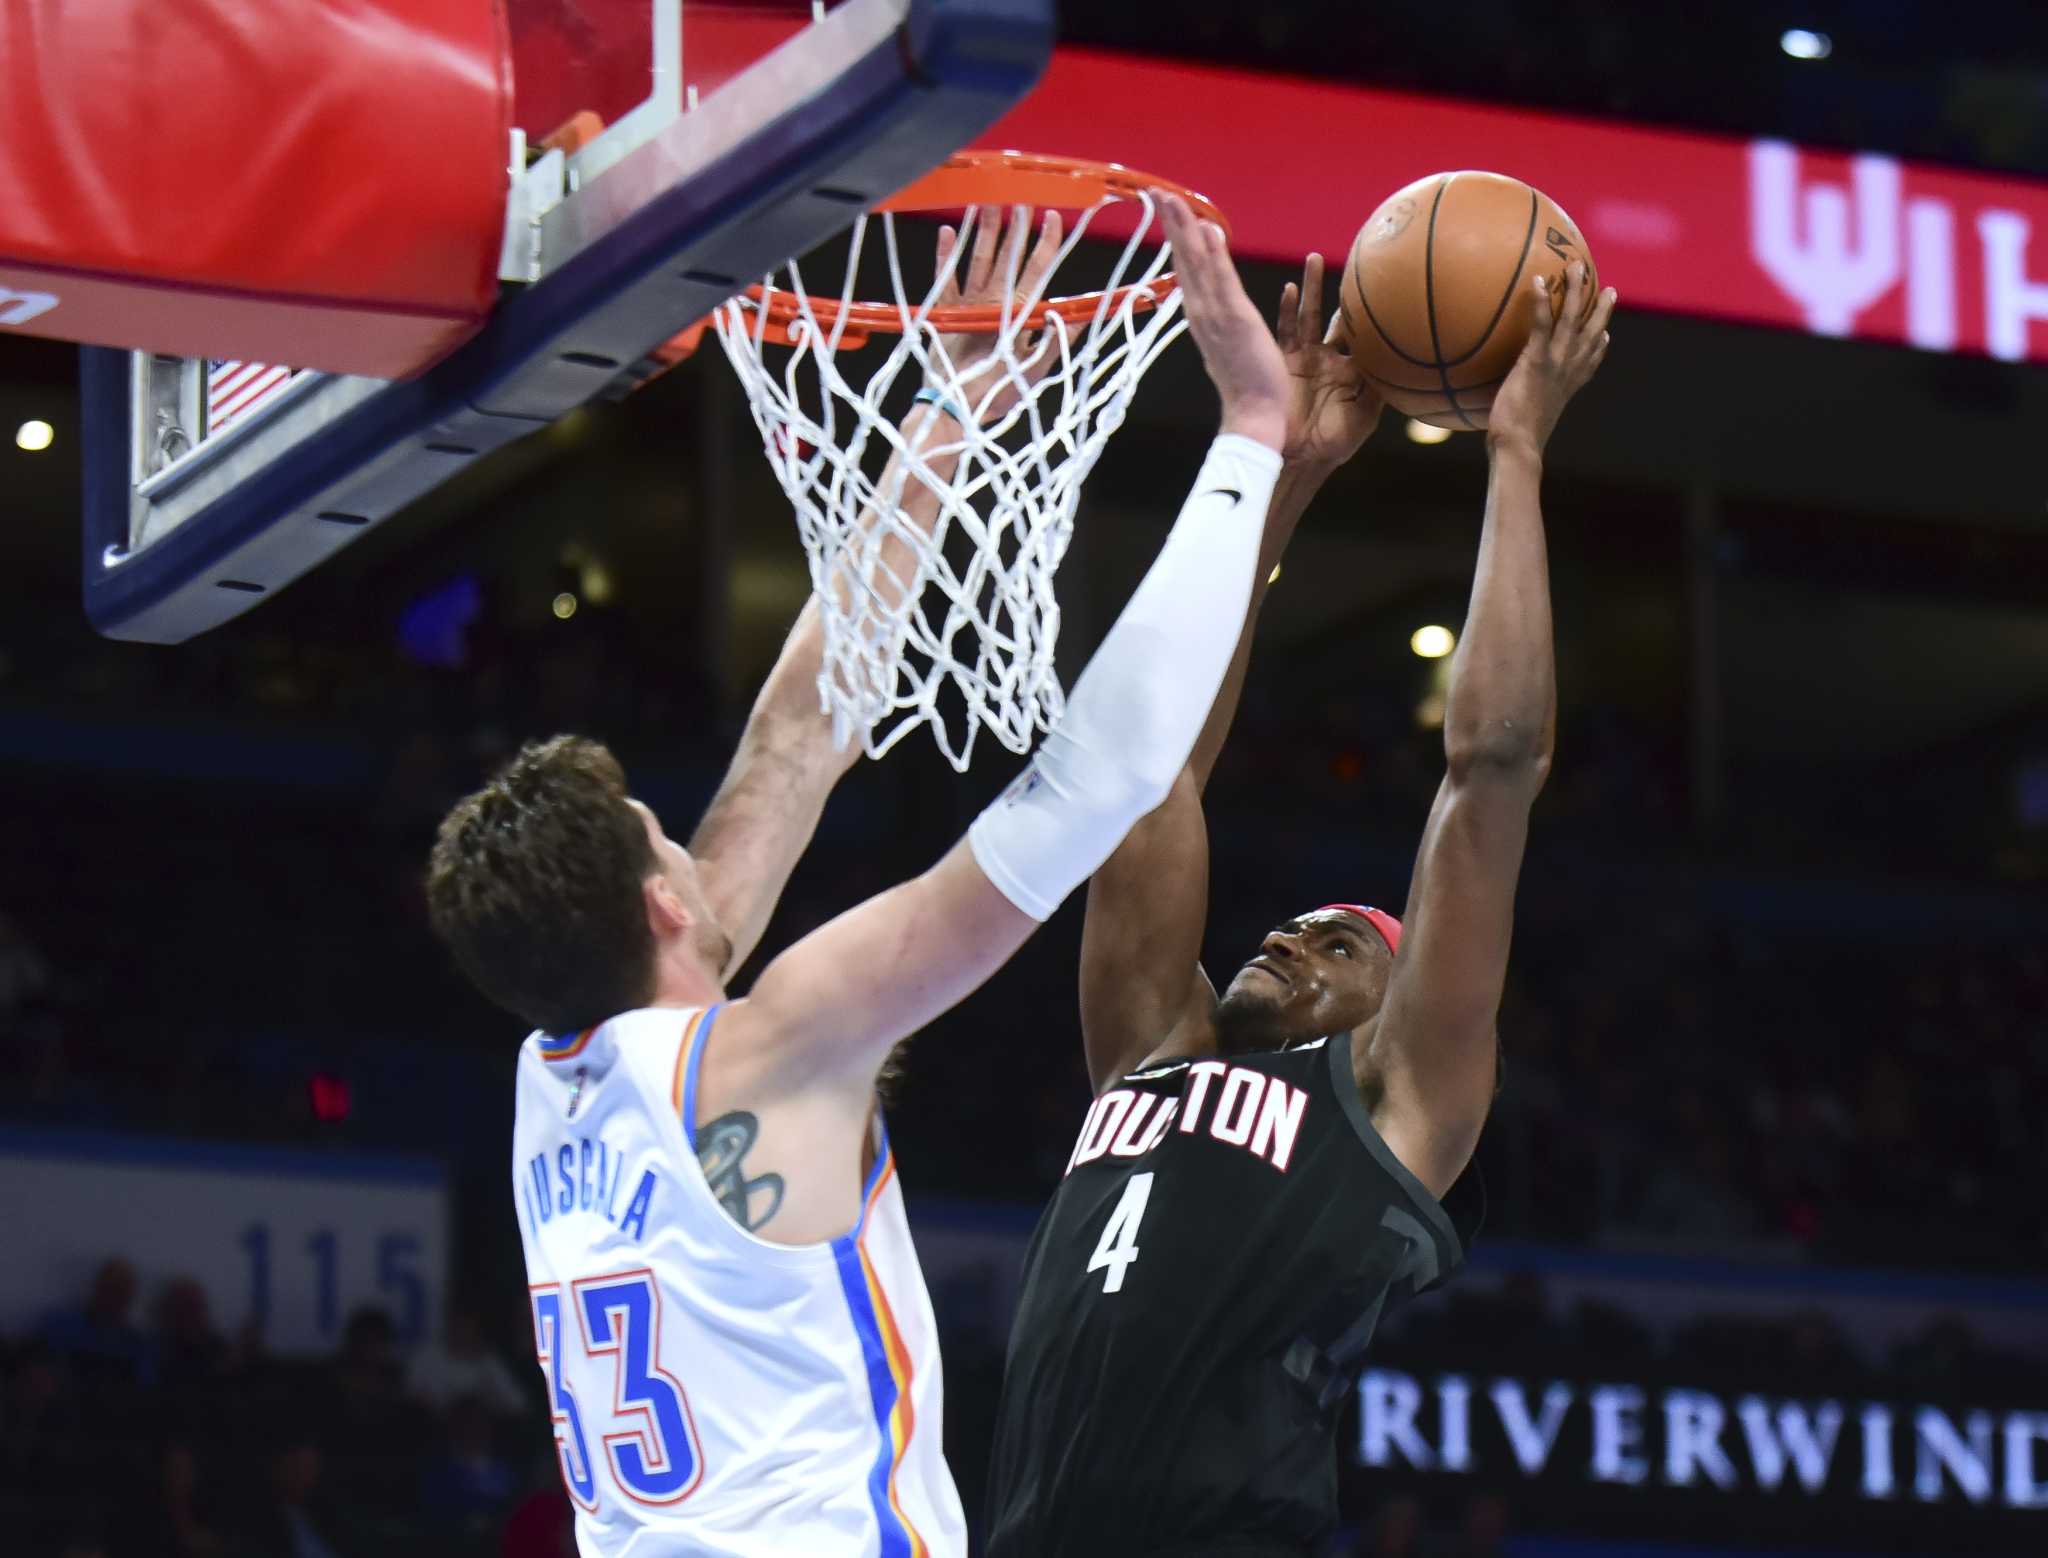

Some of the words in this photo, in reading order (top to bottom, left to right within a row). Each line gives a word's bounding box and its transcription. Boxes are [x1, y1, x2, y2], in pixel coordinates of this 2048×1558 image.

[242, 1222, 428, 1348] 115
[1086, 1171, 1155, 1294] 4
[528, 1267, 704, 1514] 33
